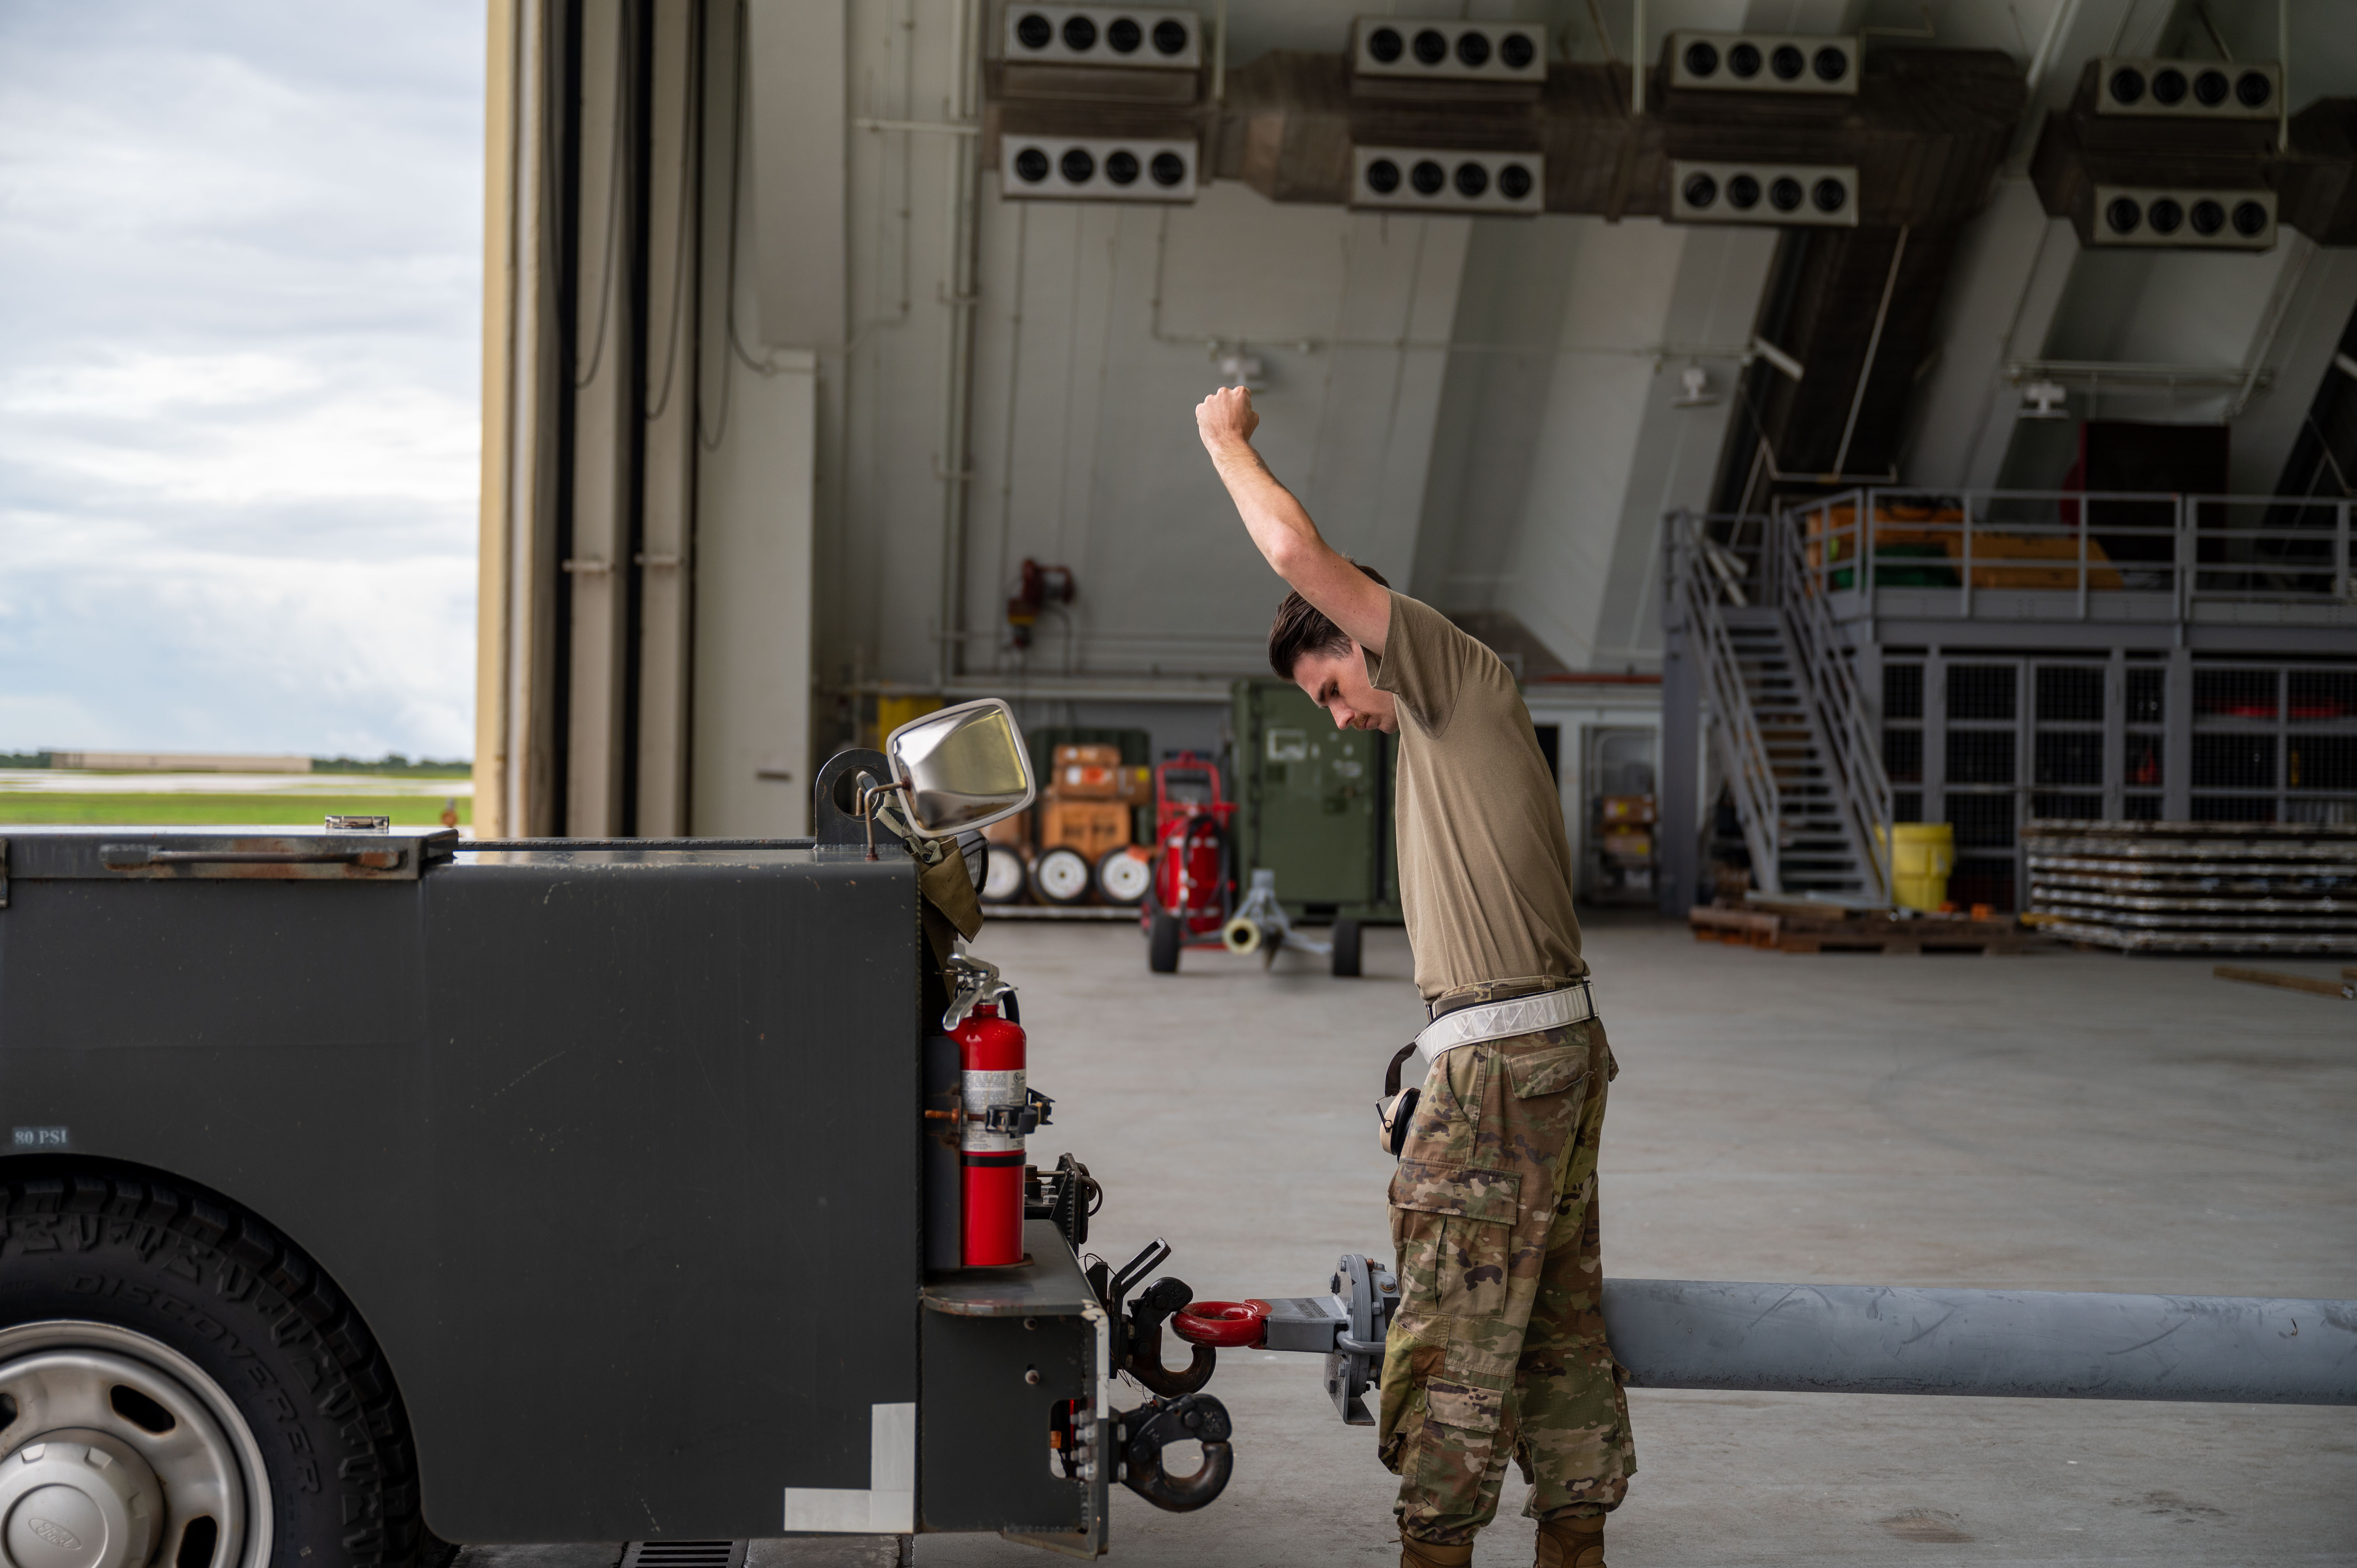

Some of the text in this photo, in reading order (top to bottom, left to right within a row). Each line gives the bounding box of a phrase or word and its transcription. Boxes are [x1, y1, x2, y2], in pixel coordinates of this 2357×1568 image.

[14, 1130, 67, 1144] 80 PSI
[1313, 1307, 1329, 1317] SPEED
[64, 1272, 322, 1492] DISCOVERER
[36, 1522, 73, 1547] Ford
